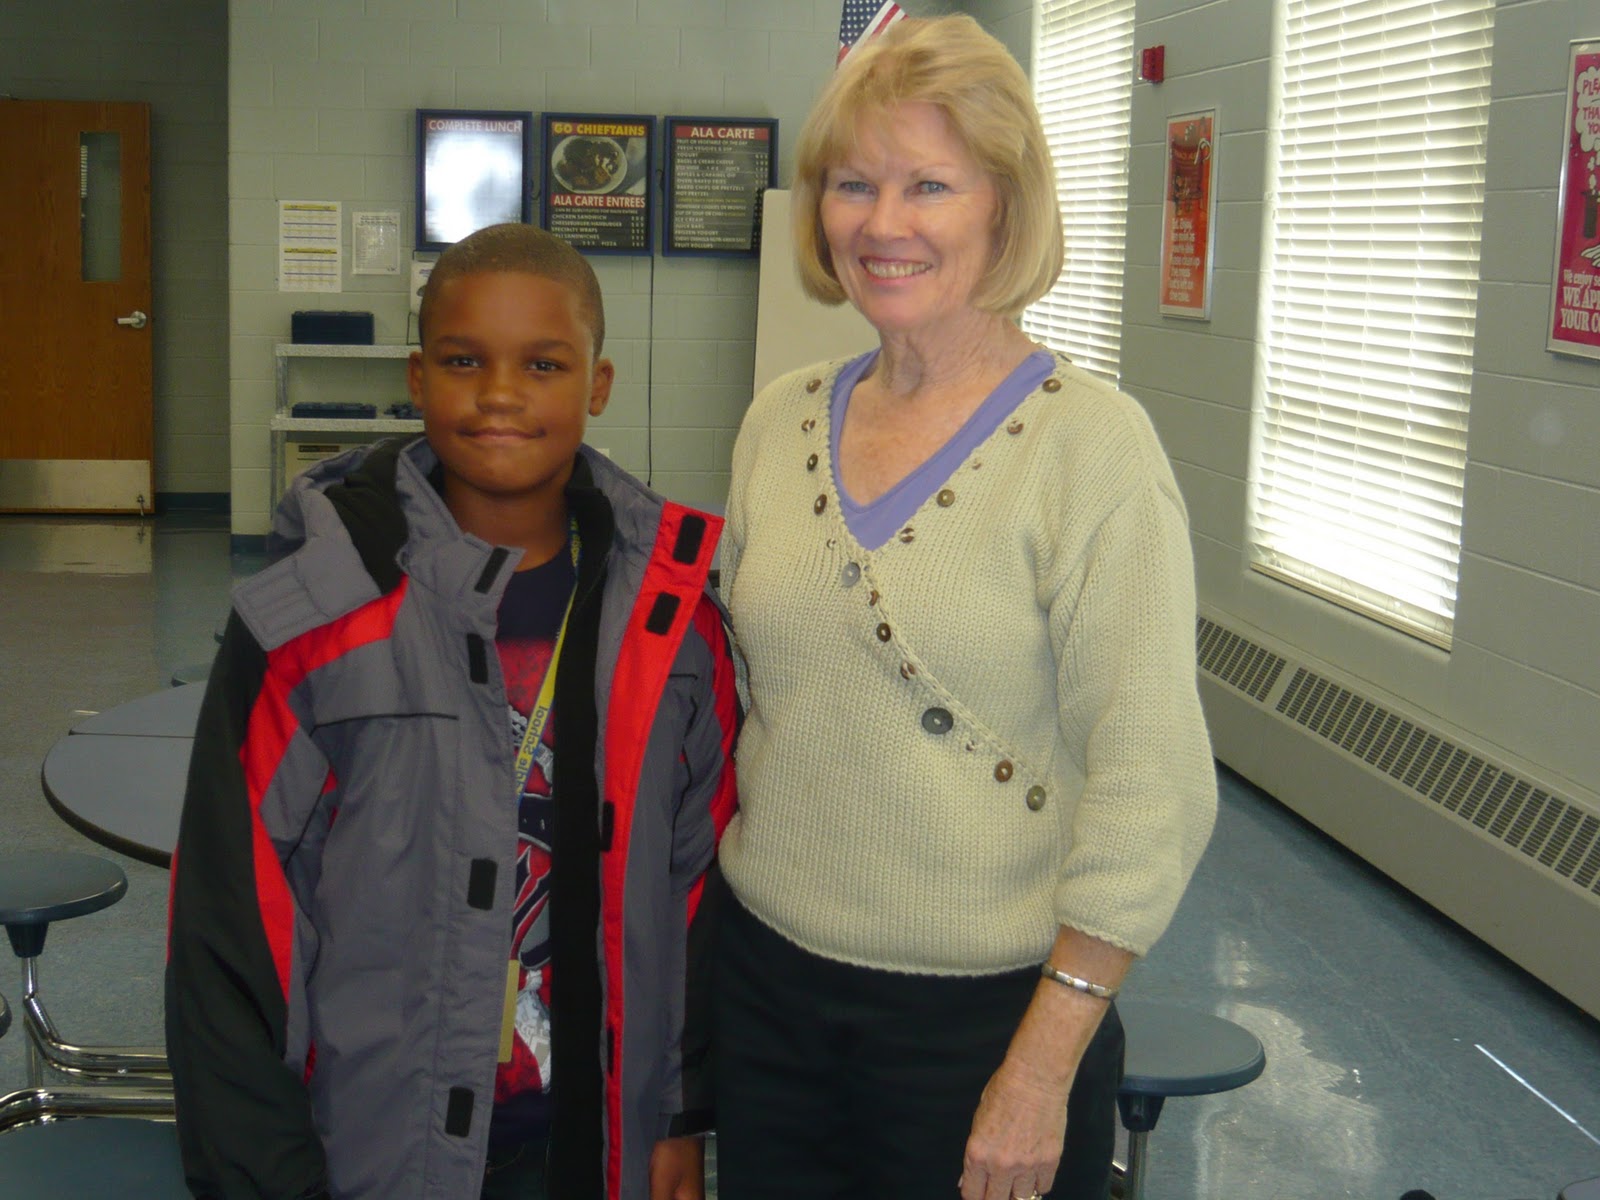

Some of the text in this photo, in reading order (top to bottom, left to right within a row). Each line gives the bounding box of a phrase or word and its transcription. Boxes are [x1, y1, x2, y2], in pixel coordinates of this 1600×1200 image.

[429, 120, 521, 132] COMPLETE LUNCH
[554, 123, 645, 136] GO CHIEFTAINS
[691, 127, 755, 139] ALA CARTE
[554, 195, 646, 208] ALA CARTE ENTREES
[1563, 269, 1573, 284] We
[1573, 271, 1593, 289] enjoy
[1563, 286, 1581, 307] WE
[1560, 308, 1590, 332] YOUR
